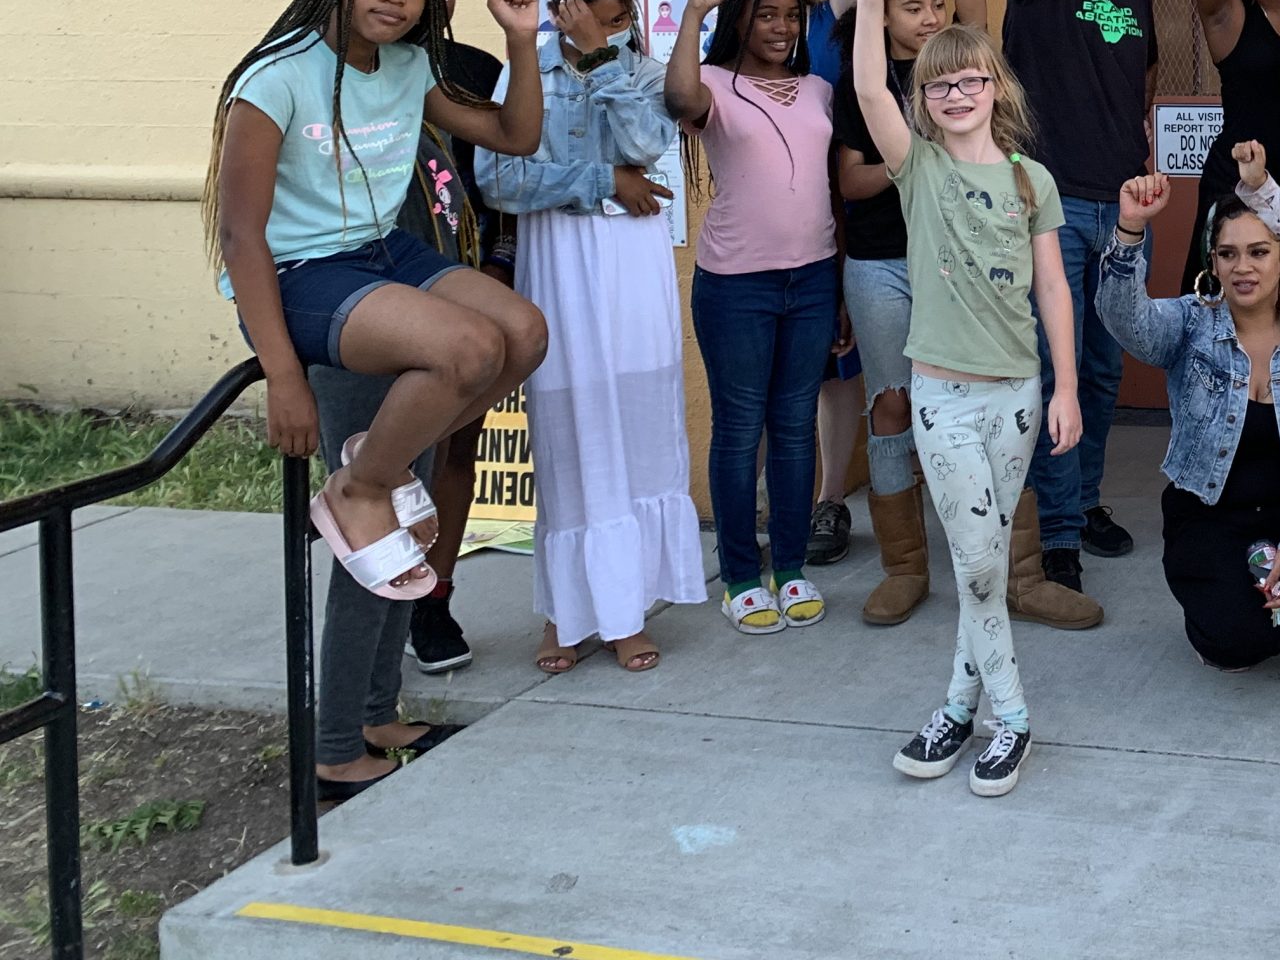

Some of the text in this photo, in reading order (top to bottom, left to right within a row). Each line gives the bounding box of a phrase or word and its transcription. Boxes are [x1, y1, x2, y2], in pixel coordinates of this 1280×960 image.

[1164, 124, 1204, 132] REPORT
[1181, 135, 1218, 151] DO NO
[475, 470, 536, 507] DENT
